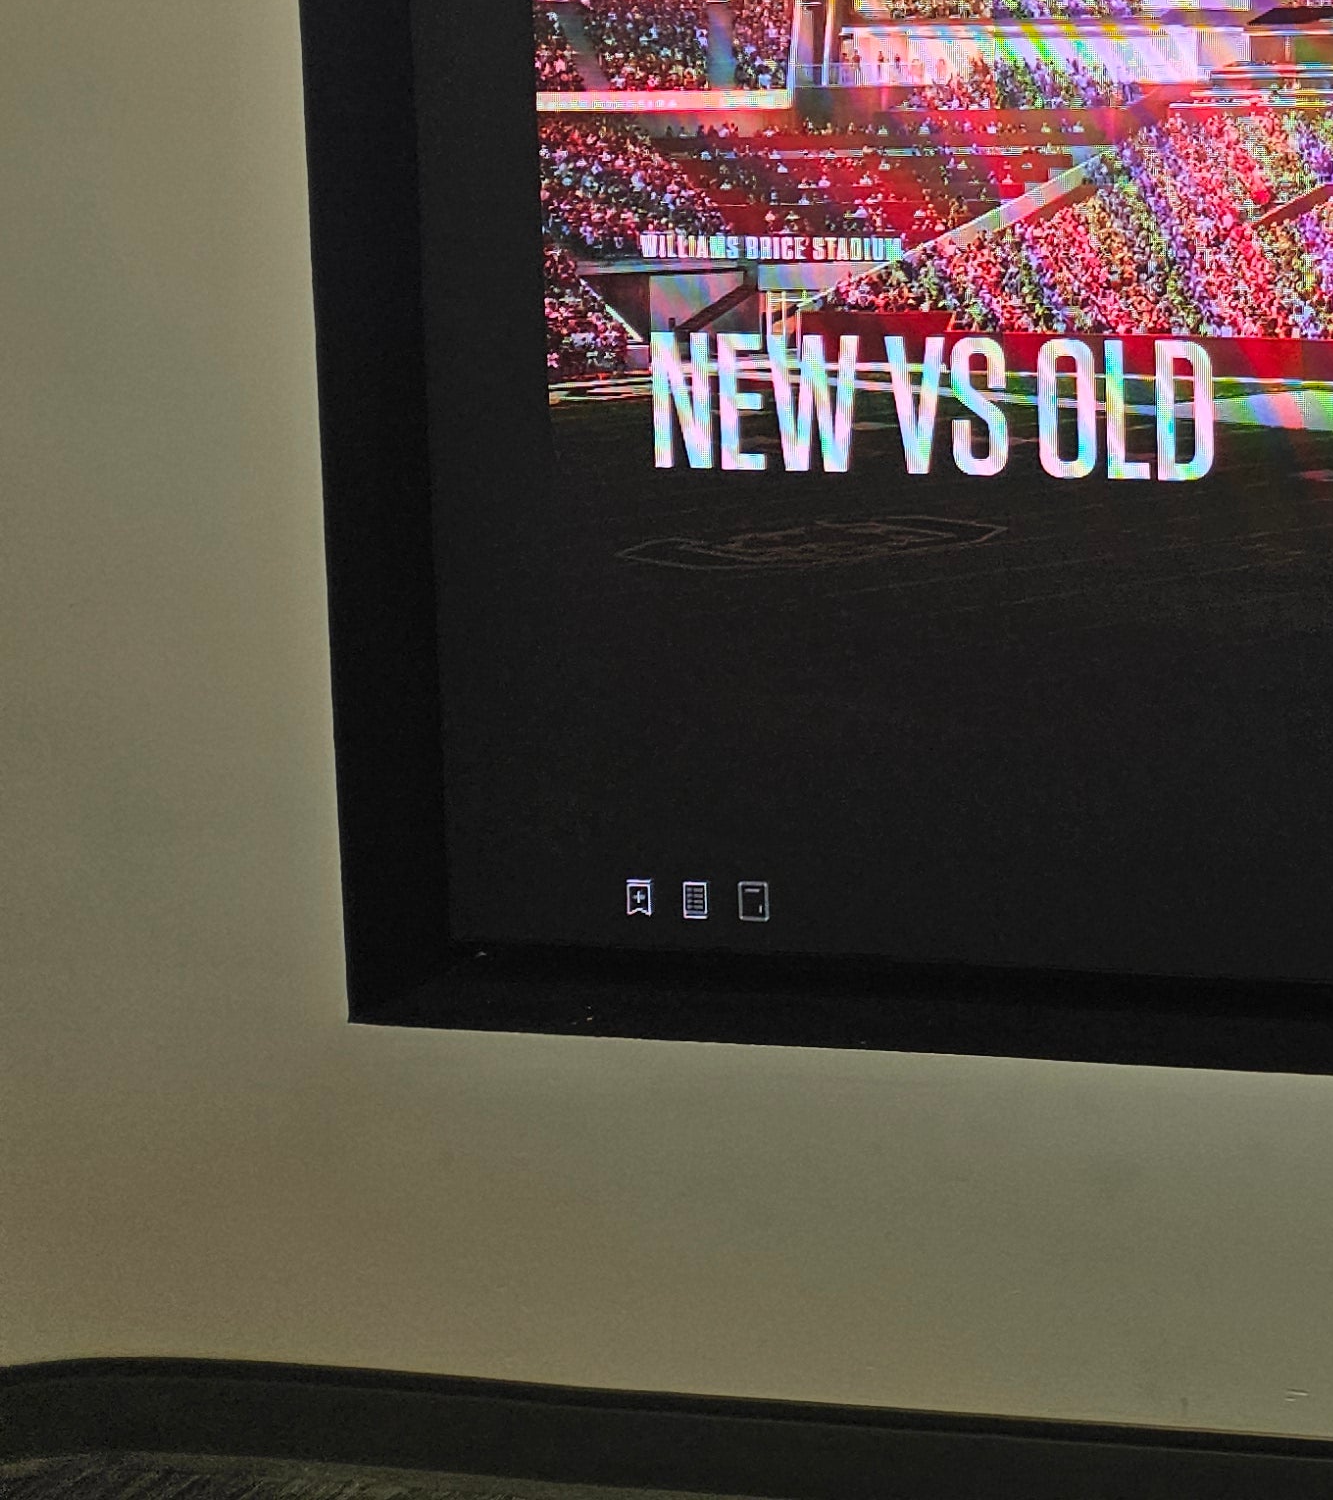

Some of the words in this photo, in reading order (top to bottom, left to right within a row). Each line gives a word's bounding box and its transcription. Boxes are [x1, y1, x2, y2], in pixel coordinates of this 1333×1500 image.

[639, 233, 739, 260] WILLIAMS
[745, 235, 807, 261] BRICE
[812, 235, 904, 263] STADIUM
[649, 330, 859, 473] NEW
[884, 334, 1009, 478] VS
[1037, 337, 1216, 482] OLD
